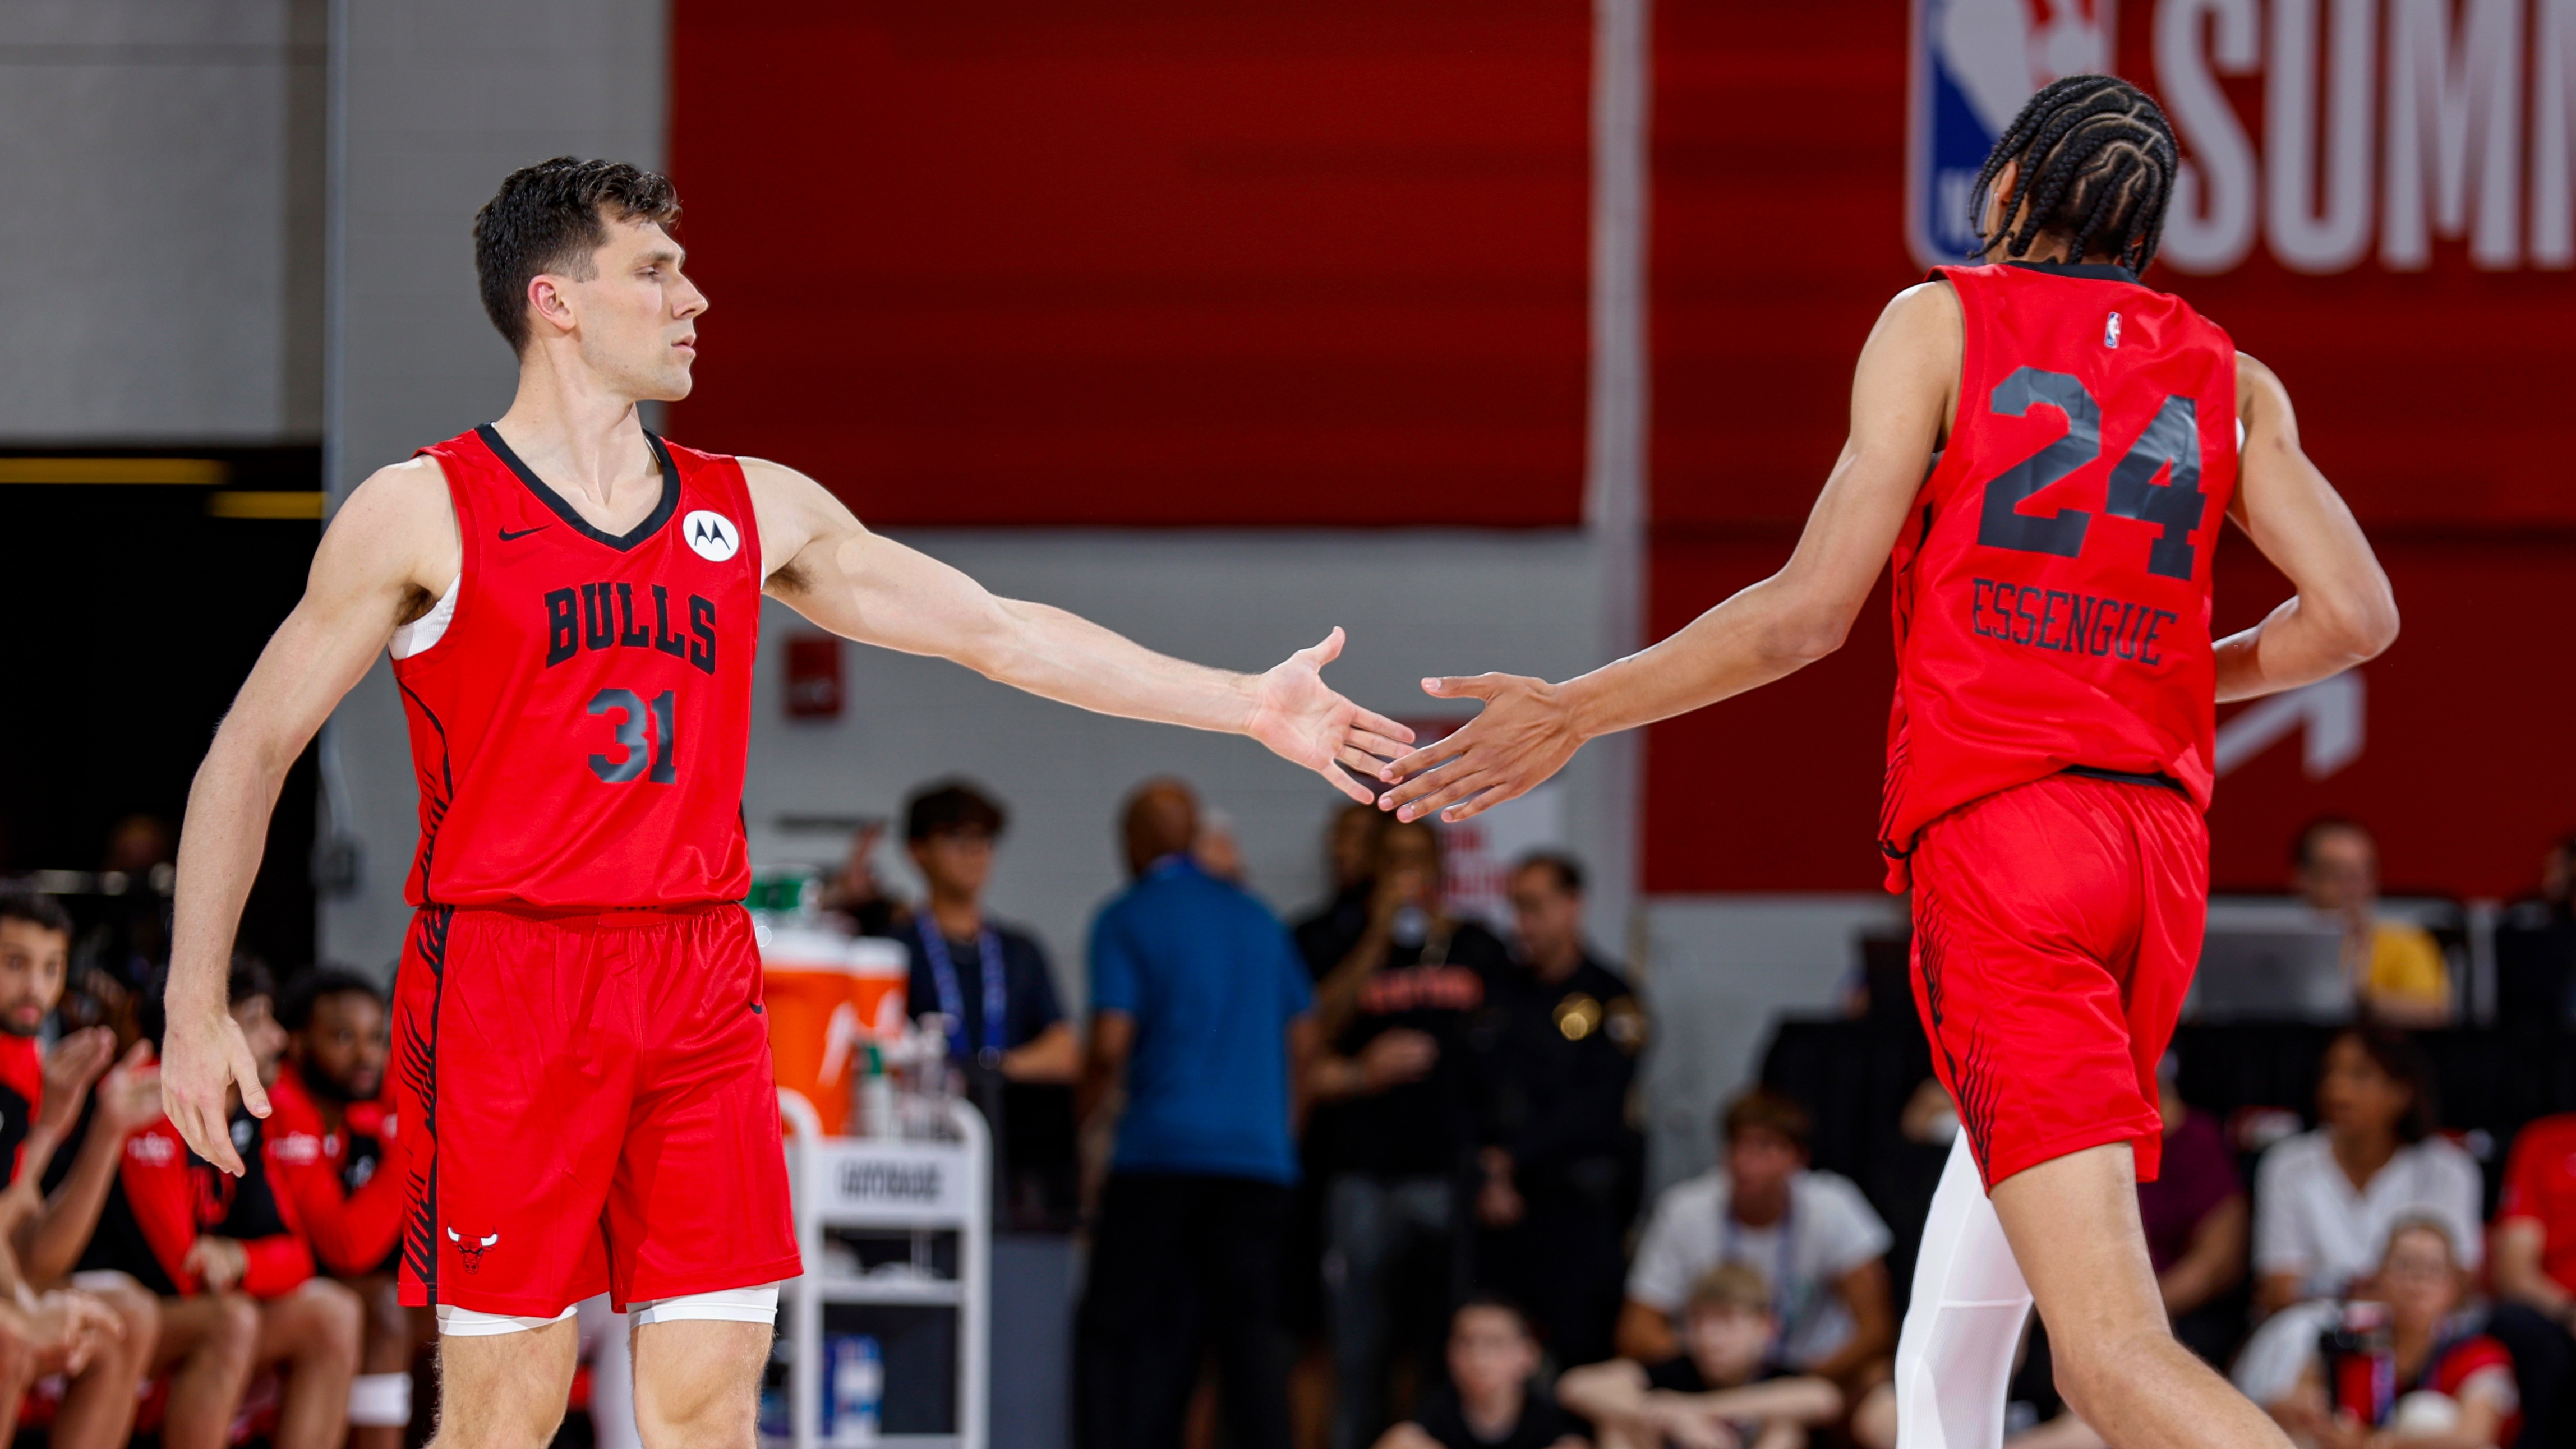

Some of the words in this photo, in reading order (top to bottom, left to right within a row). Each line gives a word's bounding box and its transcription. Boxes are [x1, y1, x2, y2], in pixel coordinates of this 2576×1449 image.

[1978, 366, 2206, 581] 24
[544, 582, 717, 675] BULLS
[1971, 578, 2178, 666] ESSENGUE
[587, 688, 676, 784] 31
